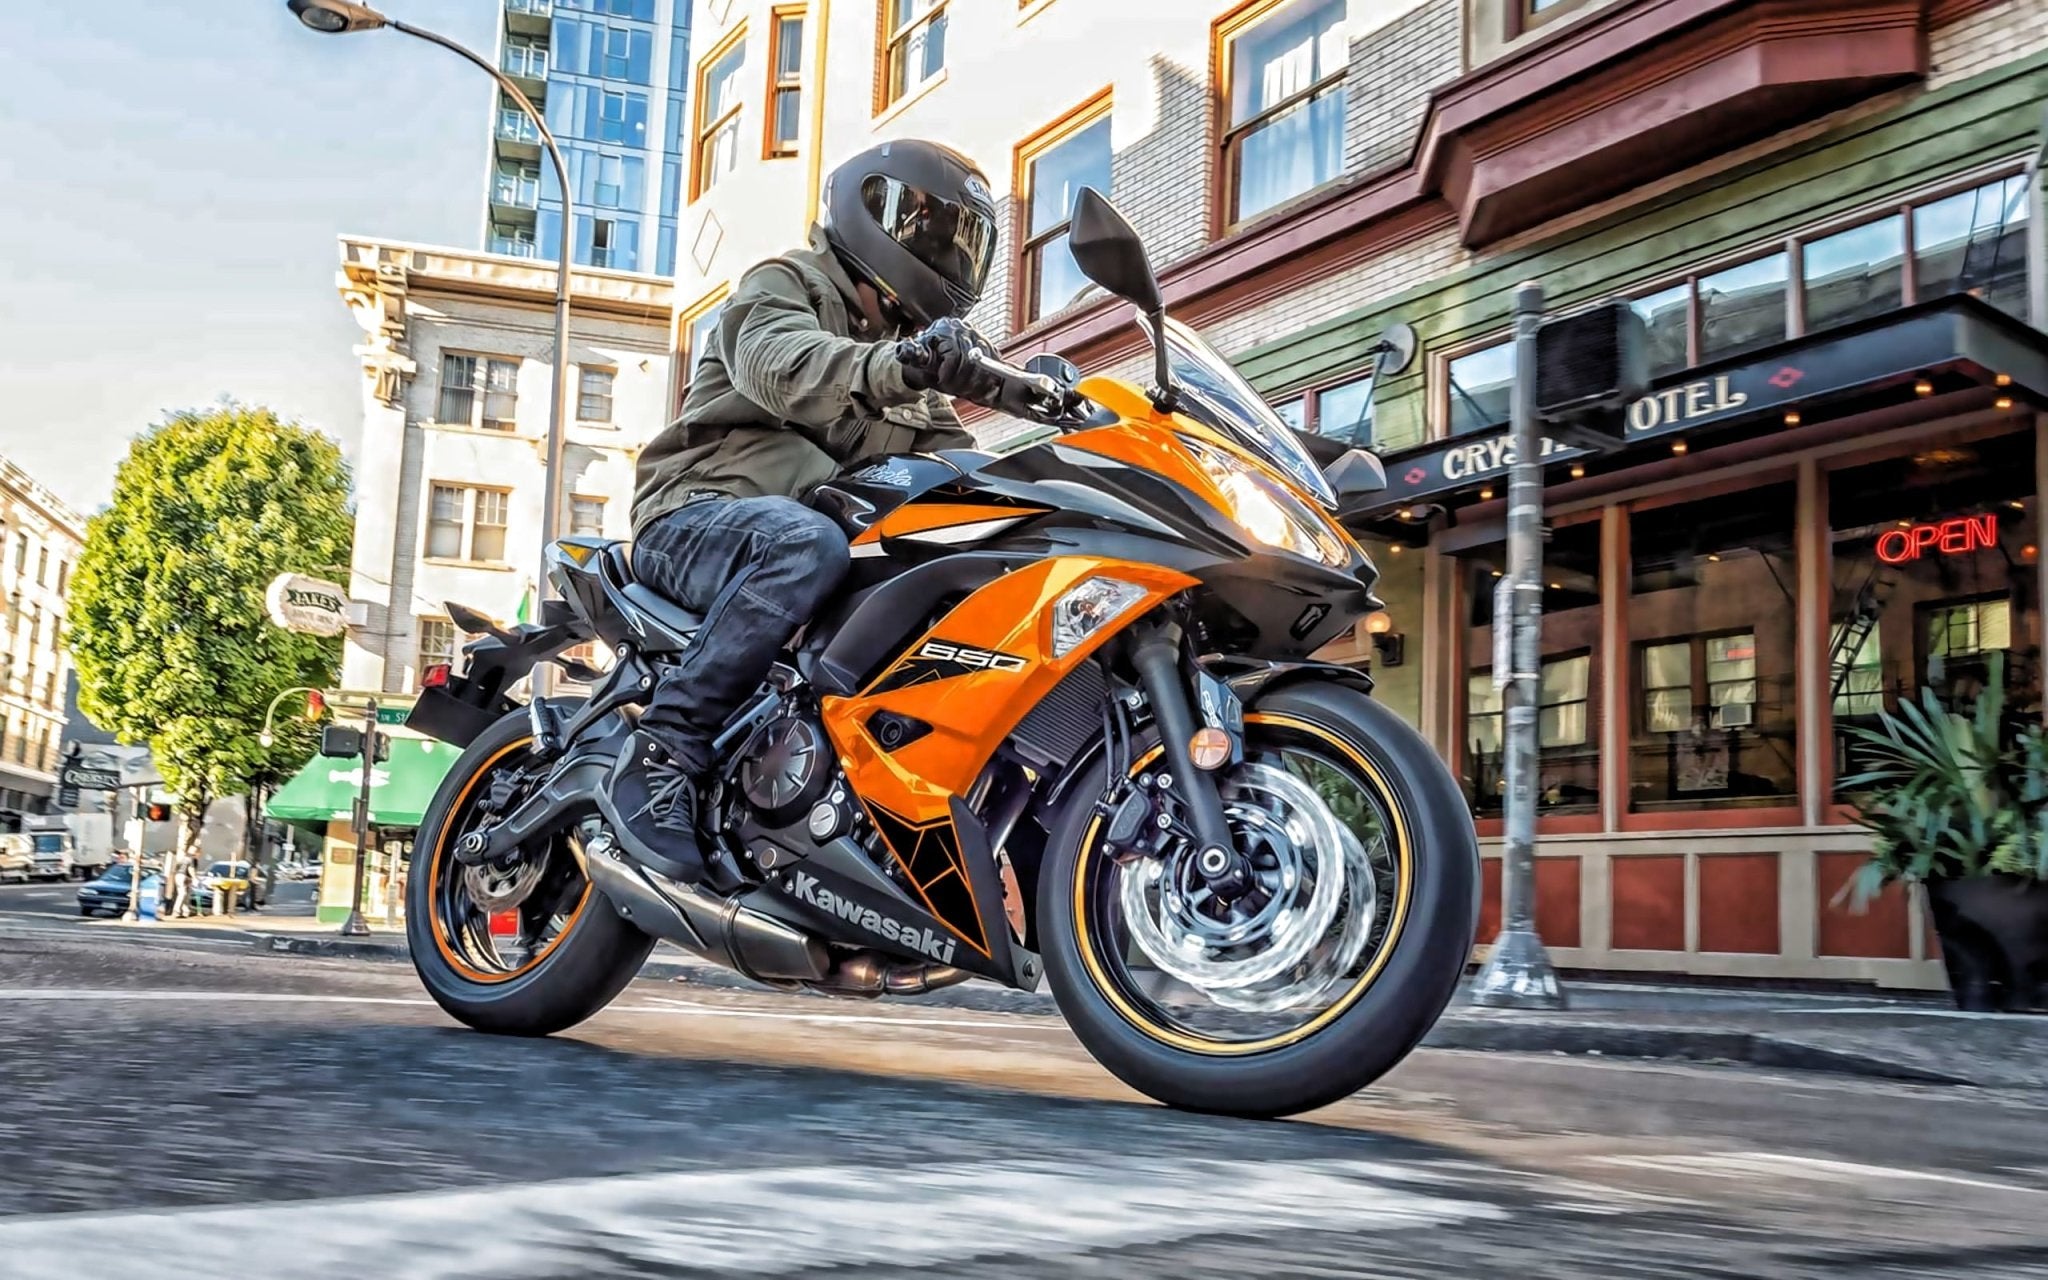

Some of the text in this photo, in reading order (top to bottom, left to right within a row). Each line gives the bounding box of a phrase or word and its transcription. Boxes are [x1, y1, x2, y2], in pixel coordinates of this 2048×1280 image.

[1624, 376, 1748, 434] OTEL
[1876, 514, 1997, 562] OPEN
[920, 642, 1027, 673] 650
[795, 870, 957, 964] Kawasaki
